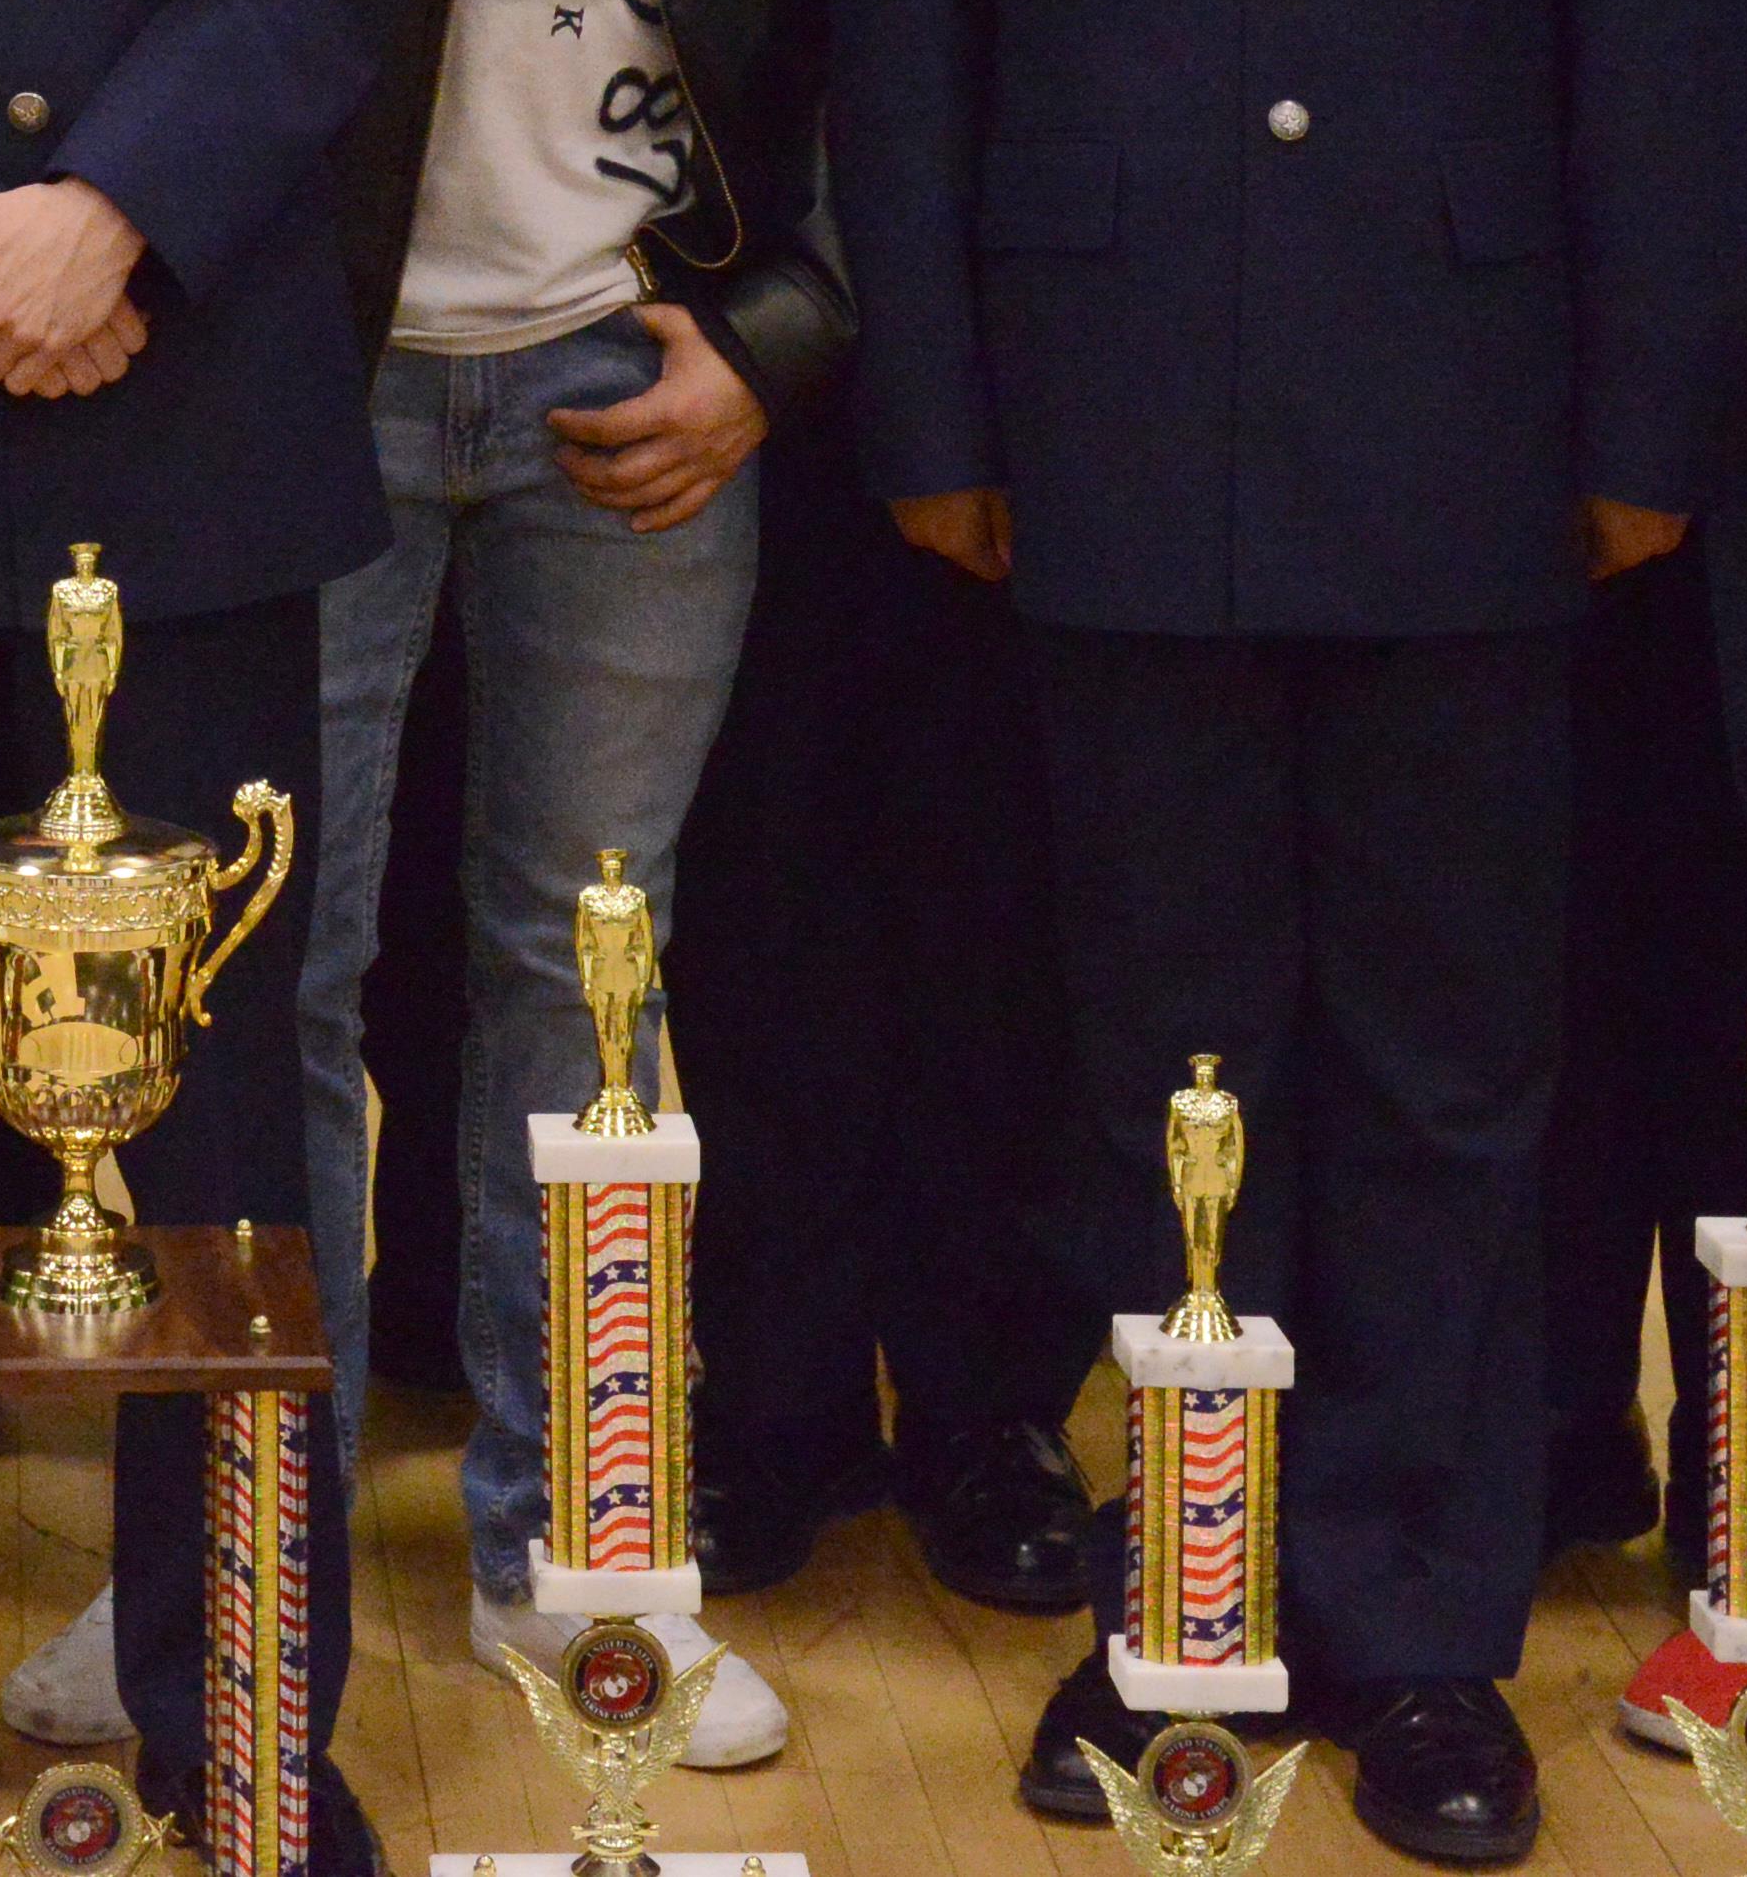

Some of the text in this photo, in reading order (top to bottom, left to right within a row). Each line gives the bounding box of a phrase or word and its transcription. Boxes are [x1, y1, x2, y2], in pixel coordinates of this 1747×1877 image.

[586, 1639, 656, 1670] UNITED STATES
[579, 1690, 646, 1721] MARINE CORPS
